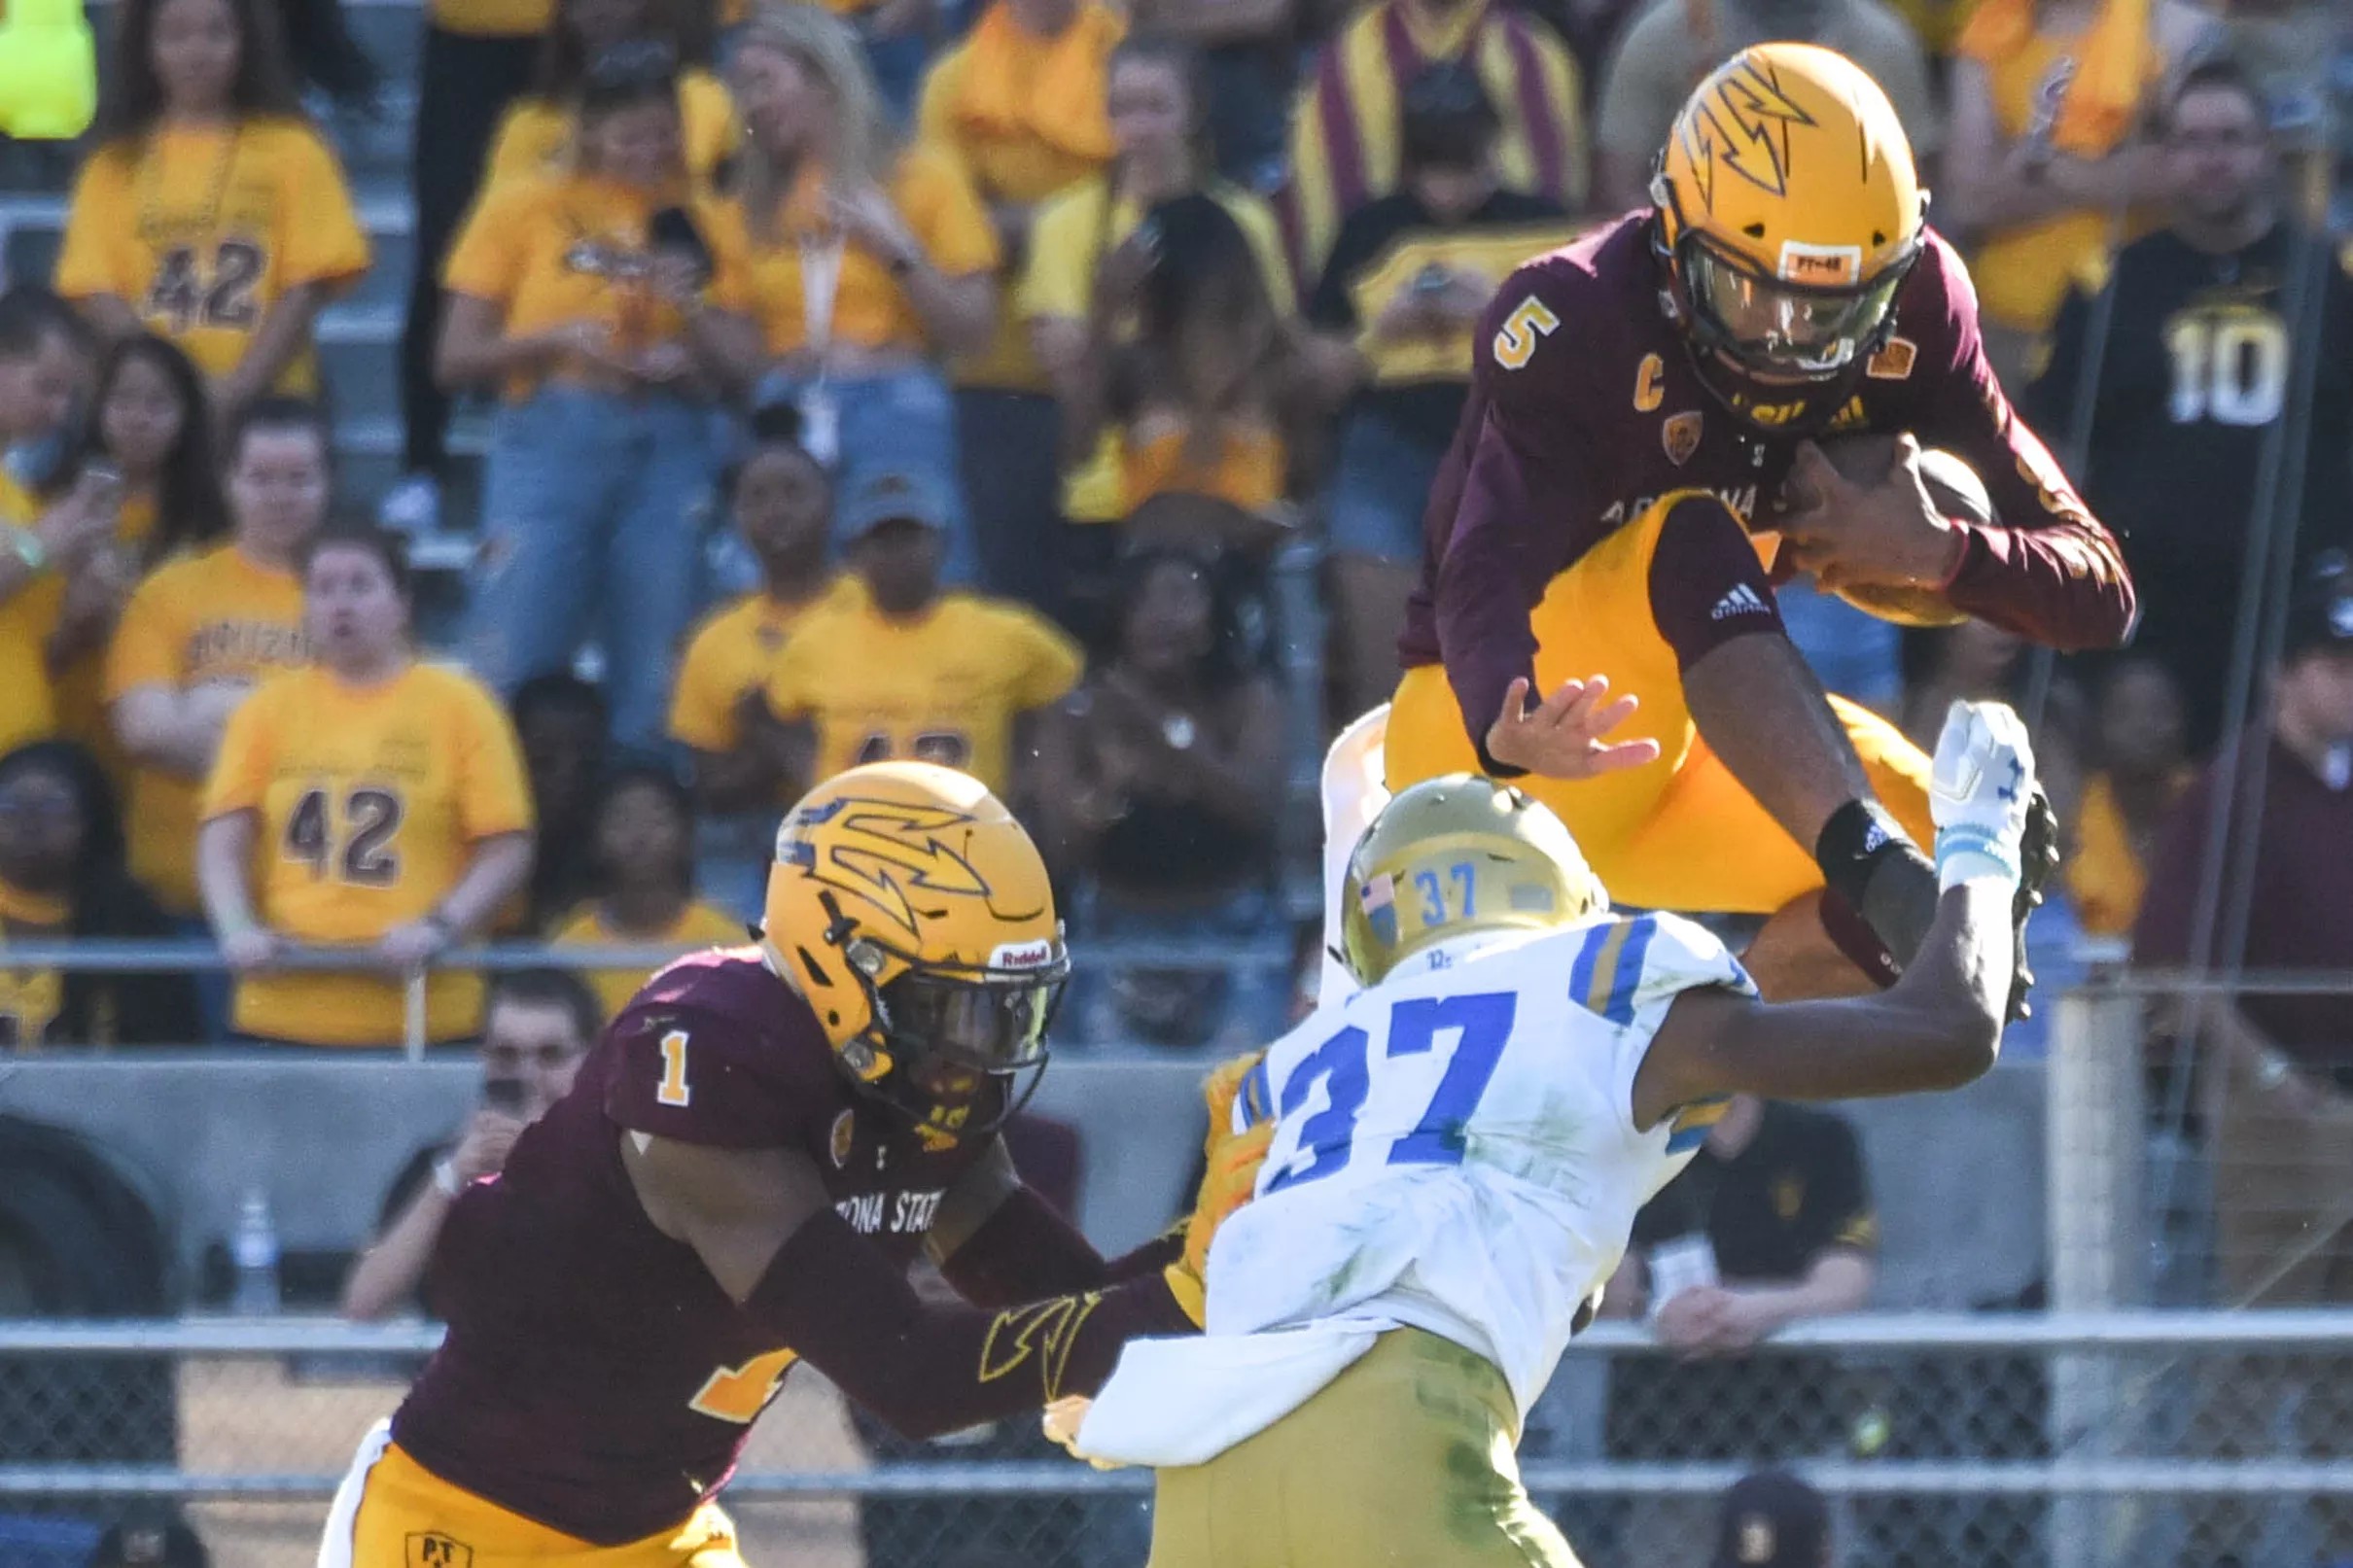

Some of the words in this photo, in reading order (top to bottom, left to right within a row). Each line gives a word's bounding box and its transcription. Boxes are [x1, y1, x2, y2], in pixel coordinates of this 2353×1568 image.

[143, 237, 266, 332] 42
[1493, 295, 1561, 369] 5
[2161, 313, 2287, 426] 10
[1633, 353, 1665, 412] C
[280, 780, 406, 889] 42
[1415, 861, 1477, 928] 37
[1002, 946, 1047, 966] Riddell
[656, 1029, 689, 1106] 1
[1262, 991, 1518, 1197] 37
